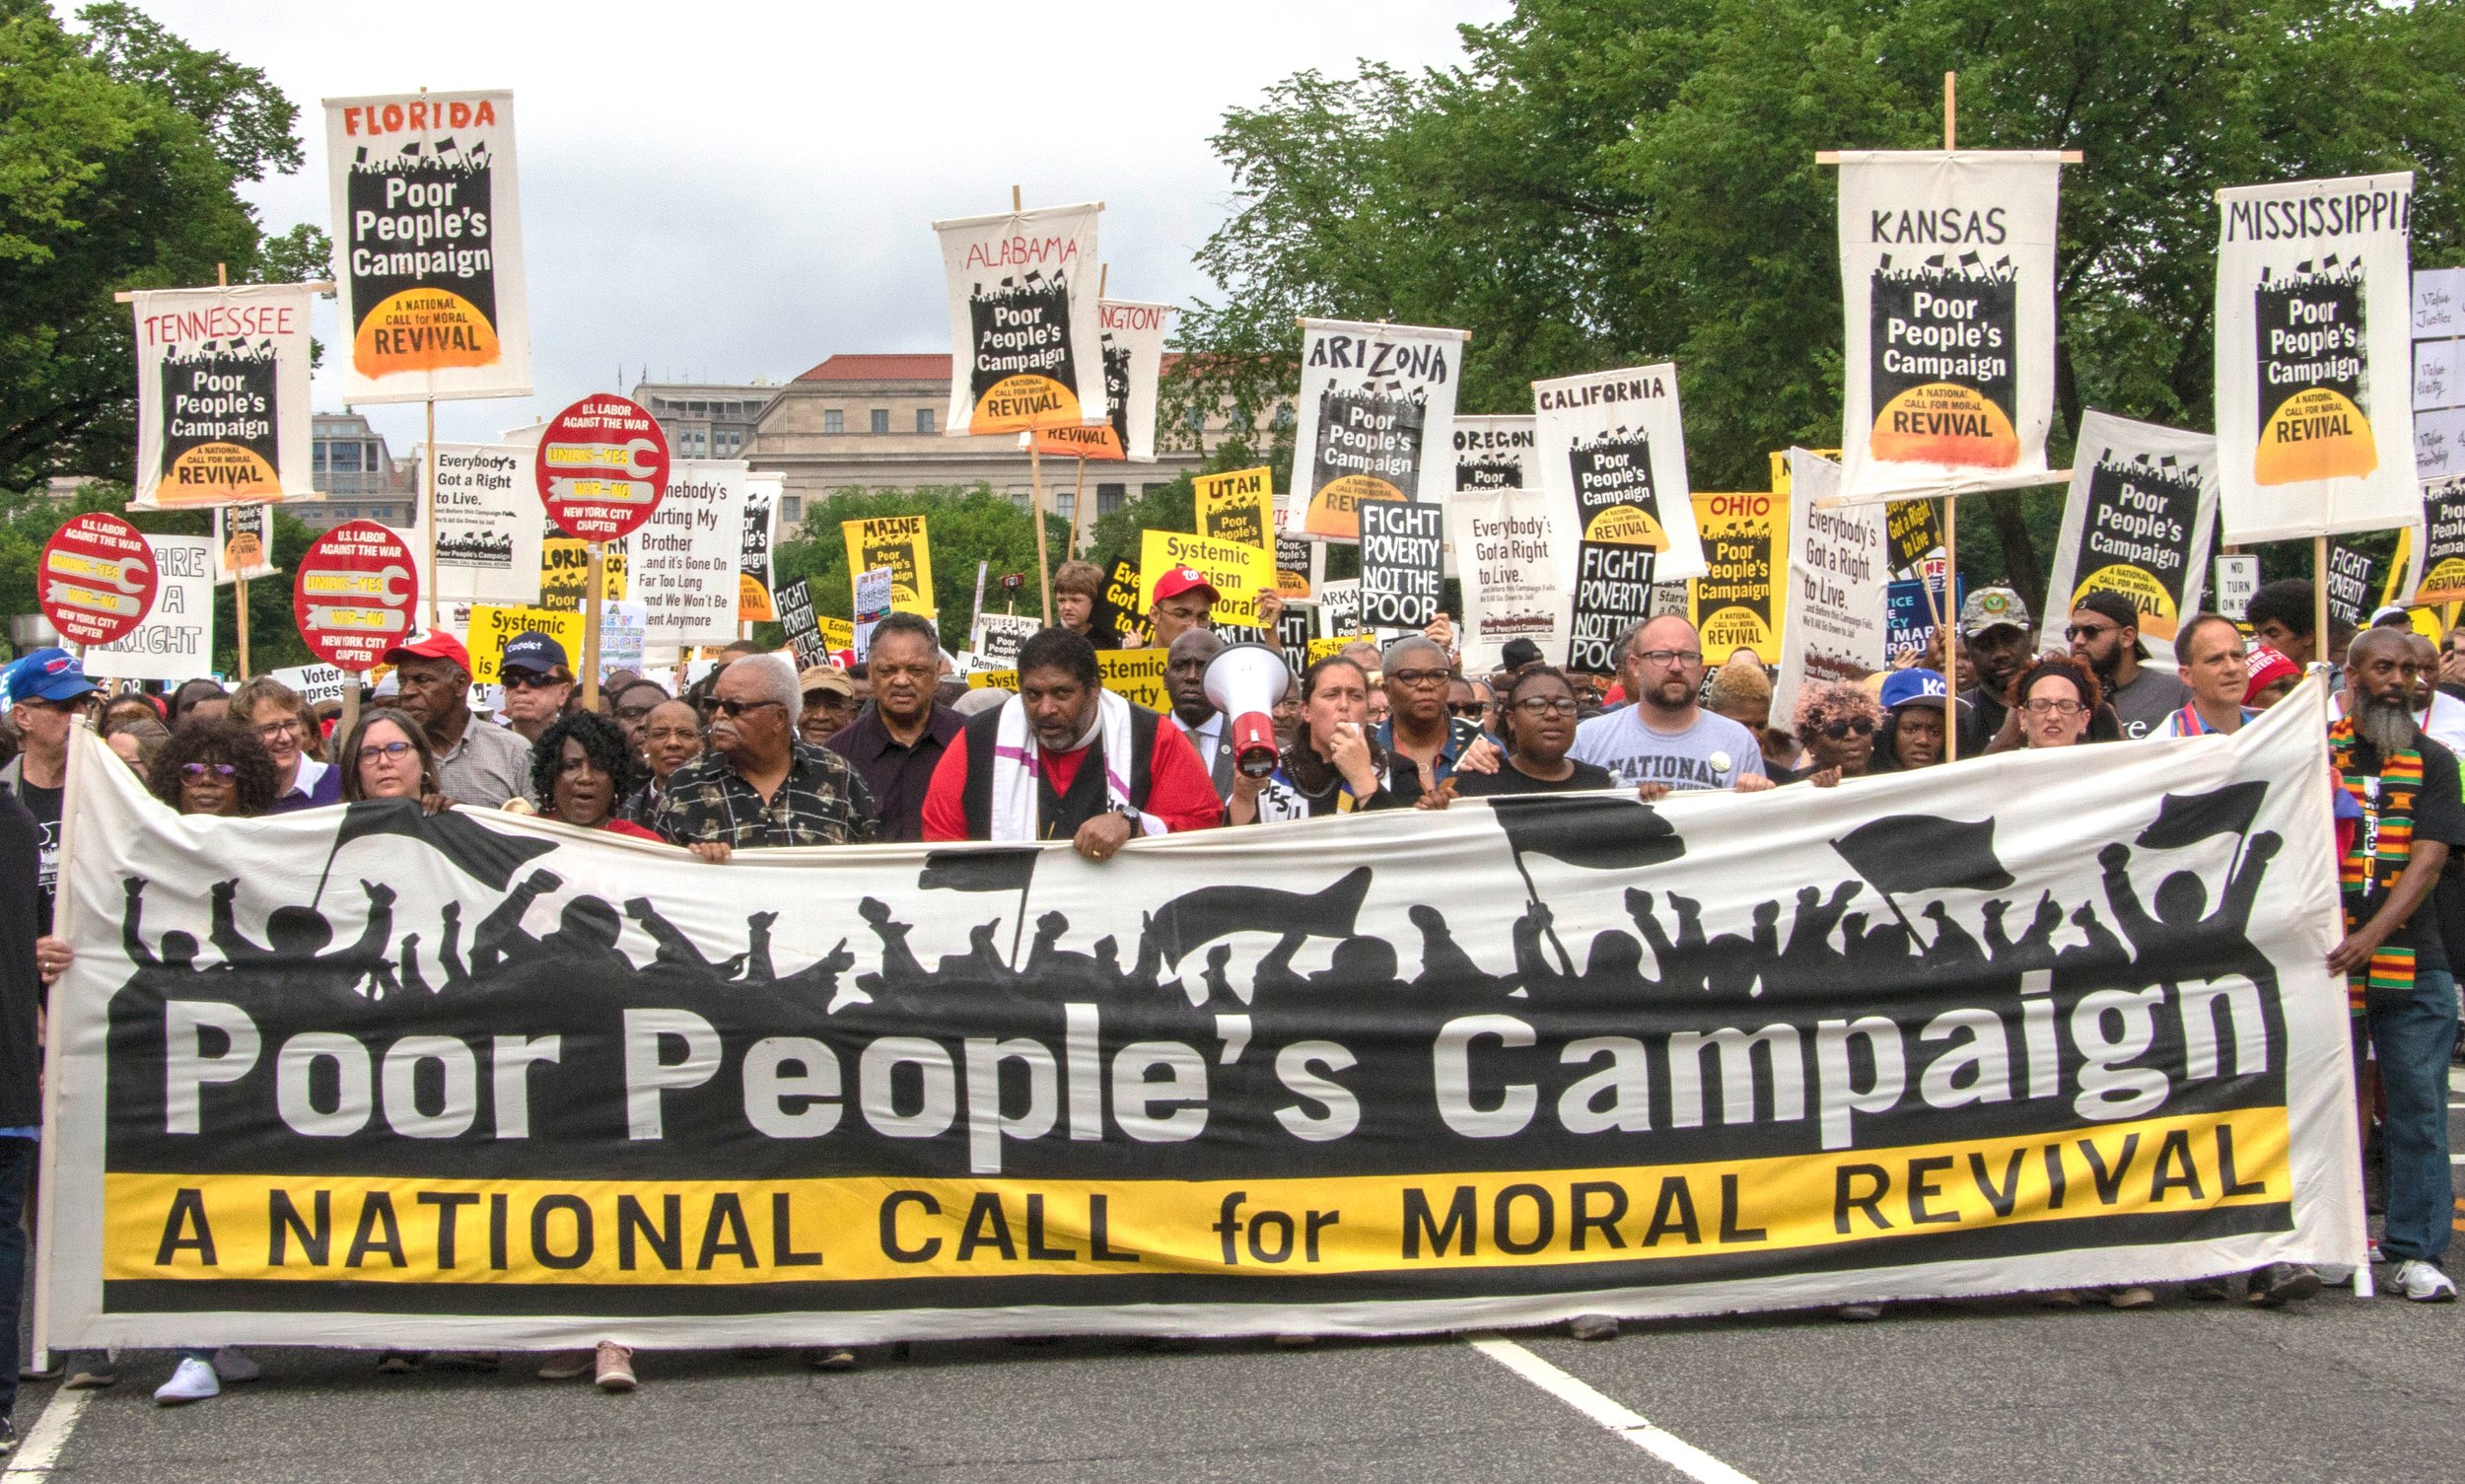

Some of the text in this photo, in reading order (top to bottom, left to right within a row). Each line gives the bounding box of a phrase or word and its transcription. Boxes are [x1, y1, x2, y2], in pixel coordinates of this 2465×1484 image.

[344, 100, 496, 137] FLORIDA
[387, 177, 457, 209] Poor
[356, 207, 487, 246] People's
[1871, 208, 2007, 245] KANSAS
[2227, 190, 2410, 242] MISSISSIPPI!
[353, 245, 491, 280] Campaign
[966, 237, 1078, 269] ALABAMA
[405, 299, 457, 311] NATIONAL
[1914, 292, 1978, 319] Poor
[2289, 299, 2338, 325] Poor
[144, 307, 294, 346] TENNESSEE
[386, 313, 468, 325] CALL for MORAL
[995, 307, 1043, 326] Poor
[375, 325, 481, 355] REVIVAL
[980, 323, 1062, 350] People's
[1888, 318, 2003, 352] People's
[2272, 322, 2357, 357] People's
[977, 347, 1065, 373] Campaign
[1308, 336, 1446, 385] ARIZONA
[1883, 349, 2007, 381] Campaign
[2268, 355, 2359, 386] Campaign
[193, 372, 246, 391] Poor
[1011, 378, 1042, 387] NATIONAL
[1540, 377, 1665, 410] CALIFORNIA
[1927, 389, 1970, 397] NATIONAL
[176, 393, 265, 418] People's
[598, 404, 632, 416] LABOR
[988, 392, 1063, 418] REVIVAL
[1904, 399, 1982, 410] CALL MORAL
[171, 418, 269, 440] Campaign
[563, 417, 649, 430] AGAINST THE WAR
[1350, 406, 1396, 430] Poor
[1894, 411, 1993, 437] REVIVAL
[2277, 414, 2353, 444] REVIVAL
[1047, 429, 1108, 445] REVIVAL
[1329, 425, 1412, 454] People's
[1453, 431, 1534, 451] OREGON
[439, 455, 517, 471] Everybody's
[1324, 448, 1412, 475] Campaign
[1594, 454, 1629, 470] Poor
[179, 465, 263, 484] REVIVAL
[438, 473, 512, 490] Got a Right
[1475, 471, 1505, 483] Poor
[1583, 466, 1646, 488] People's
[1209, 475, 1261, 499] UTAH
[1583, 486, 1650, 506] Campaign
[2120, 482, 2168, 514] Poor
[436, 492, 481, 506] to Live.
[1711, 496, 1770, 516] OHIO
[563, 507, 633, 520] NEW YORK CITY
[697, 509, 718, 530] My
[1222, 517, 1248, 528] Poor
[1364, 505, 1440, 536] FIGHT
[1907, 501, 1931, 528] Right
[2097, 504, 2183, 542] People's
[97, 522, 127, 536] LABOR
[353, 530, 387, 543] LABOR
[577, 521, 617, 532] CHAPTER
[864, 518, 920, 537] MAINE
[1594, 521, 1651, 539] REVIVAL
[1808, 502, 1877, 551] Everybody's
[118, 537, 142, 551] WAR
[320, 544, 402, 557] AGAINST THE WAR
[642, 533, 693, 551] Brother
[1167, 536, 1250, 566] Systemic
[1277, 540, 1300, 549] Poor
[1365, 534, 1440, 567] POVERTY
[1476, 540, 1549, 563] Got Right
[1717, 542, 1754, 560] Poor
[1910, 530, 1929, 552] Live
[2090, 531, 2181, 569] Campaign
[669, 557, 727, 570] it's Gone On
[878, 551, 900, 561] Poor
[1584, 548, 1654, 580] FIGHT
[1806, 537, 1870, 585] Got Right
[2330, 546, 2371, 581] FIGHT
[1479, 565, 1523, 584] to Live.
[1707, 560, 1768, 582] People's
[2230, 562, 2243, 573] NO
[639, 574, 702, 591] Far Too Long
[1361, 566, 1439, 595] NOT THE
[2226, 582, 2250, 593] TURN
[2327, 571, 2366, 605] POVERTY
[162, 586, 184, 613] A
[547, 594, 577, 606] Poor
[666, 595, 728, 608] We Won't Be
[776, 581, 810, 611] FIGHT
[1107, 584, 1136, 610] Got
[1580, 580, 1650, 613] POVERTY
[1699, 583, 1770, 601] Campaign
[1804, 574, 1848, 610] to Live.
[1363, 594, 1438, 624] POOR
[2222, 599, 2234, 610] ON
[67, 622, 104, 639] CHAPTER
[491, 610, 565, 638] Systemic
[666, 613, 712, 629] Anymore
[782, 603, 815, 636] POVERTY
[1114, 612, 1132, 632] to
[1572, 612, 1613, 641] NOT
[365, 637, 387, 648] CITY
[997, 637, 1016, 646] Poor
[1708, 629, 1762, 645] REVIVAL
[478, 657, 492, 674] is
[302, 670, 341, 684] Voter
[162, 967, 2271, 1177] Poor People's Campaign
[153, 1122, 2270, 1273] A NATIONAL CALL for MORAL REVIVAL
